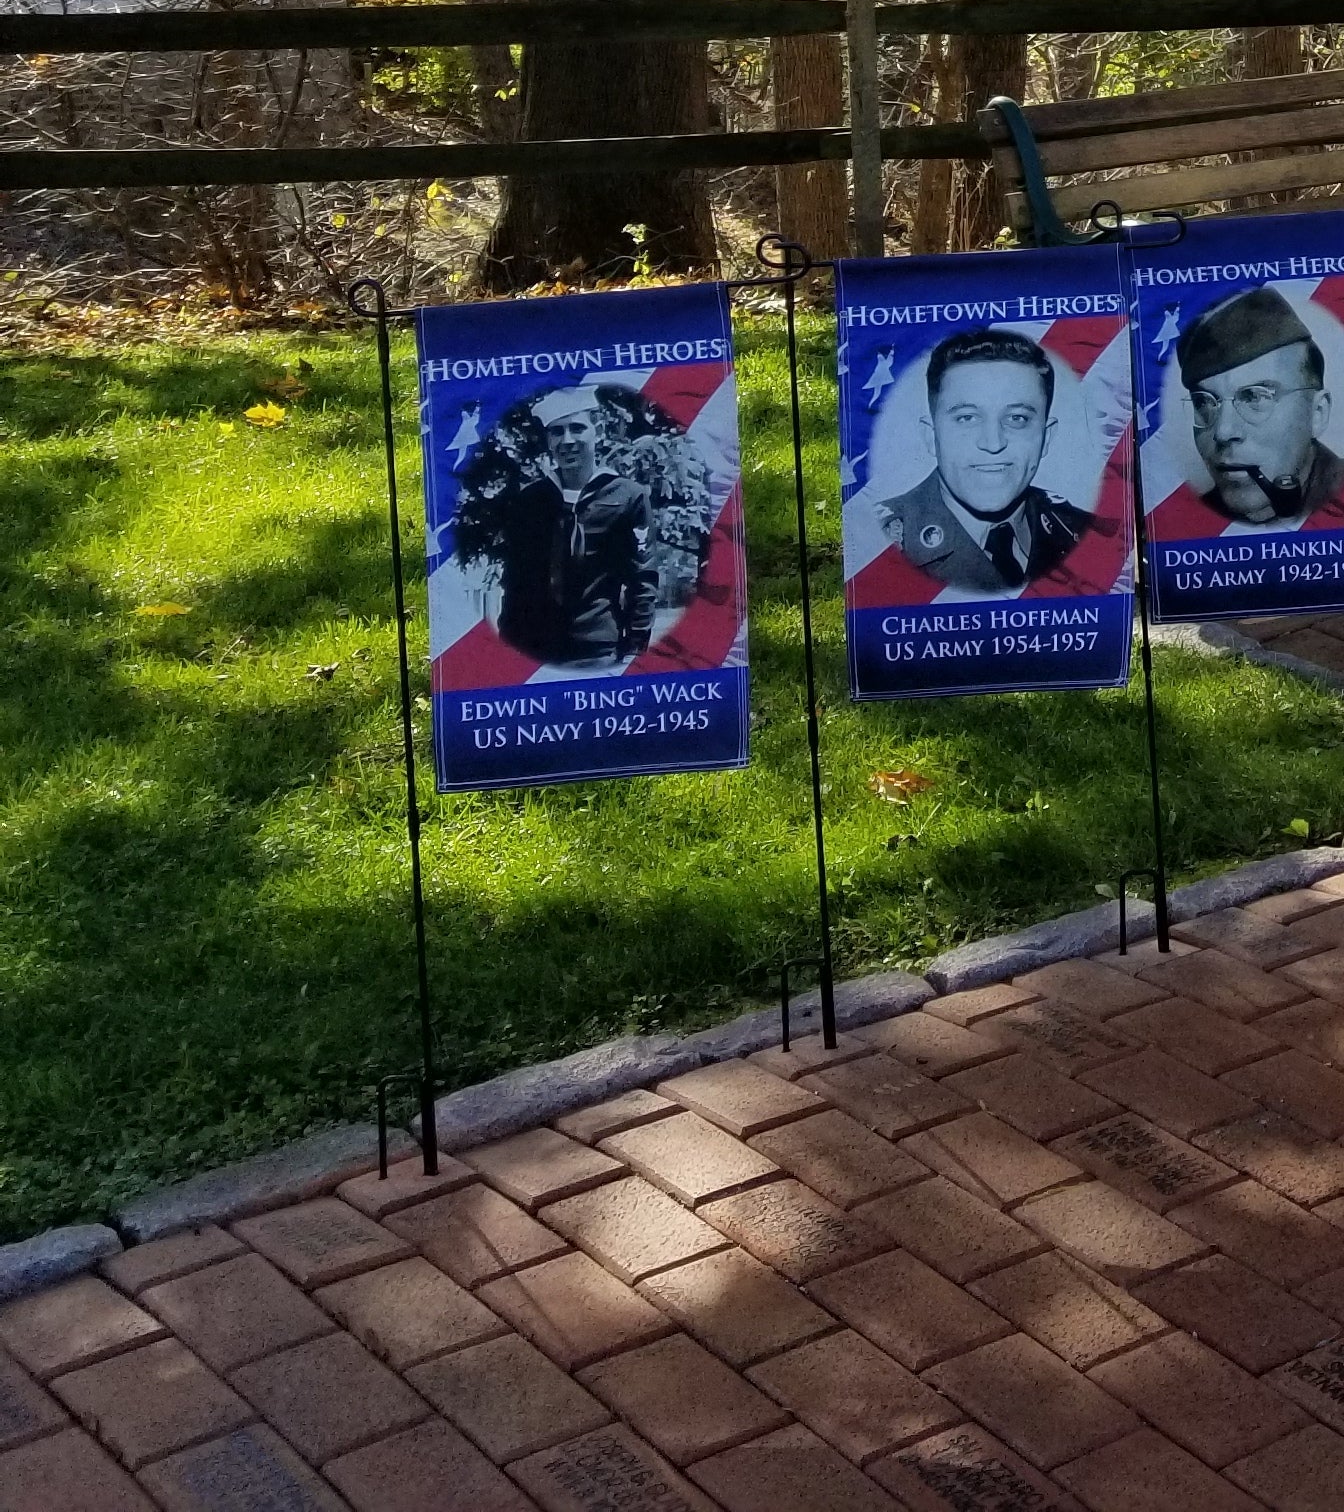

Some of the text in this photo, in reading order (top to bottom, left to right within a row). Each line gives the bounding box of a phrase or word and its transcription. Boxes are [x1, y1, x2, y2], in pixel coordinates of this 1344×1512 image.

[1136, 261, 1280, 287] HOMETOWN
[847, 294, 1119, 327] HOMETOWN HEROES
[427, 338, 723, 382] HOMETOWN HEROES
[1164, 546, 1254, 567] DONALD
[1176, 572, 1203, 590] US
[1208, 569, 1267, 588] ARMY
[881, 607, 1100, 635] CHARLES HOFFMAN
[884, 631, 1099, 661] US ARMY 1954-1957
[460, 682, 723, 723] EDWIN "BING" WACK
[474, 709, 710, 749] US NAVY 1942-1945
